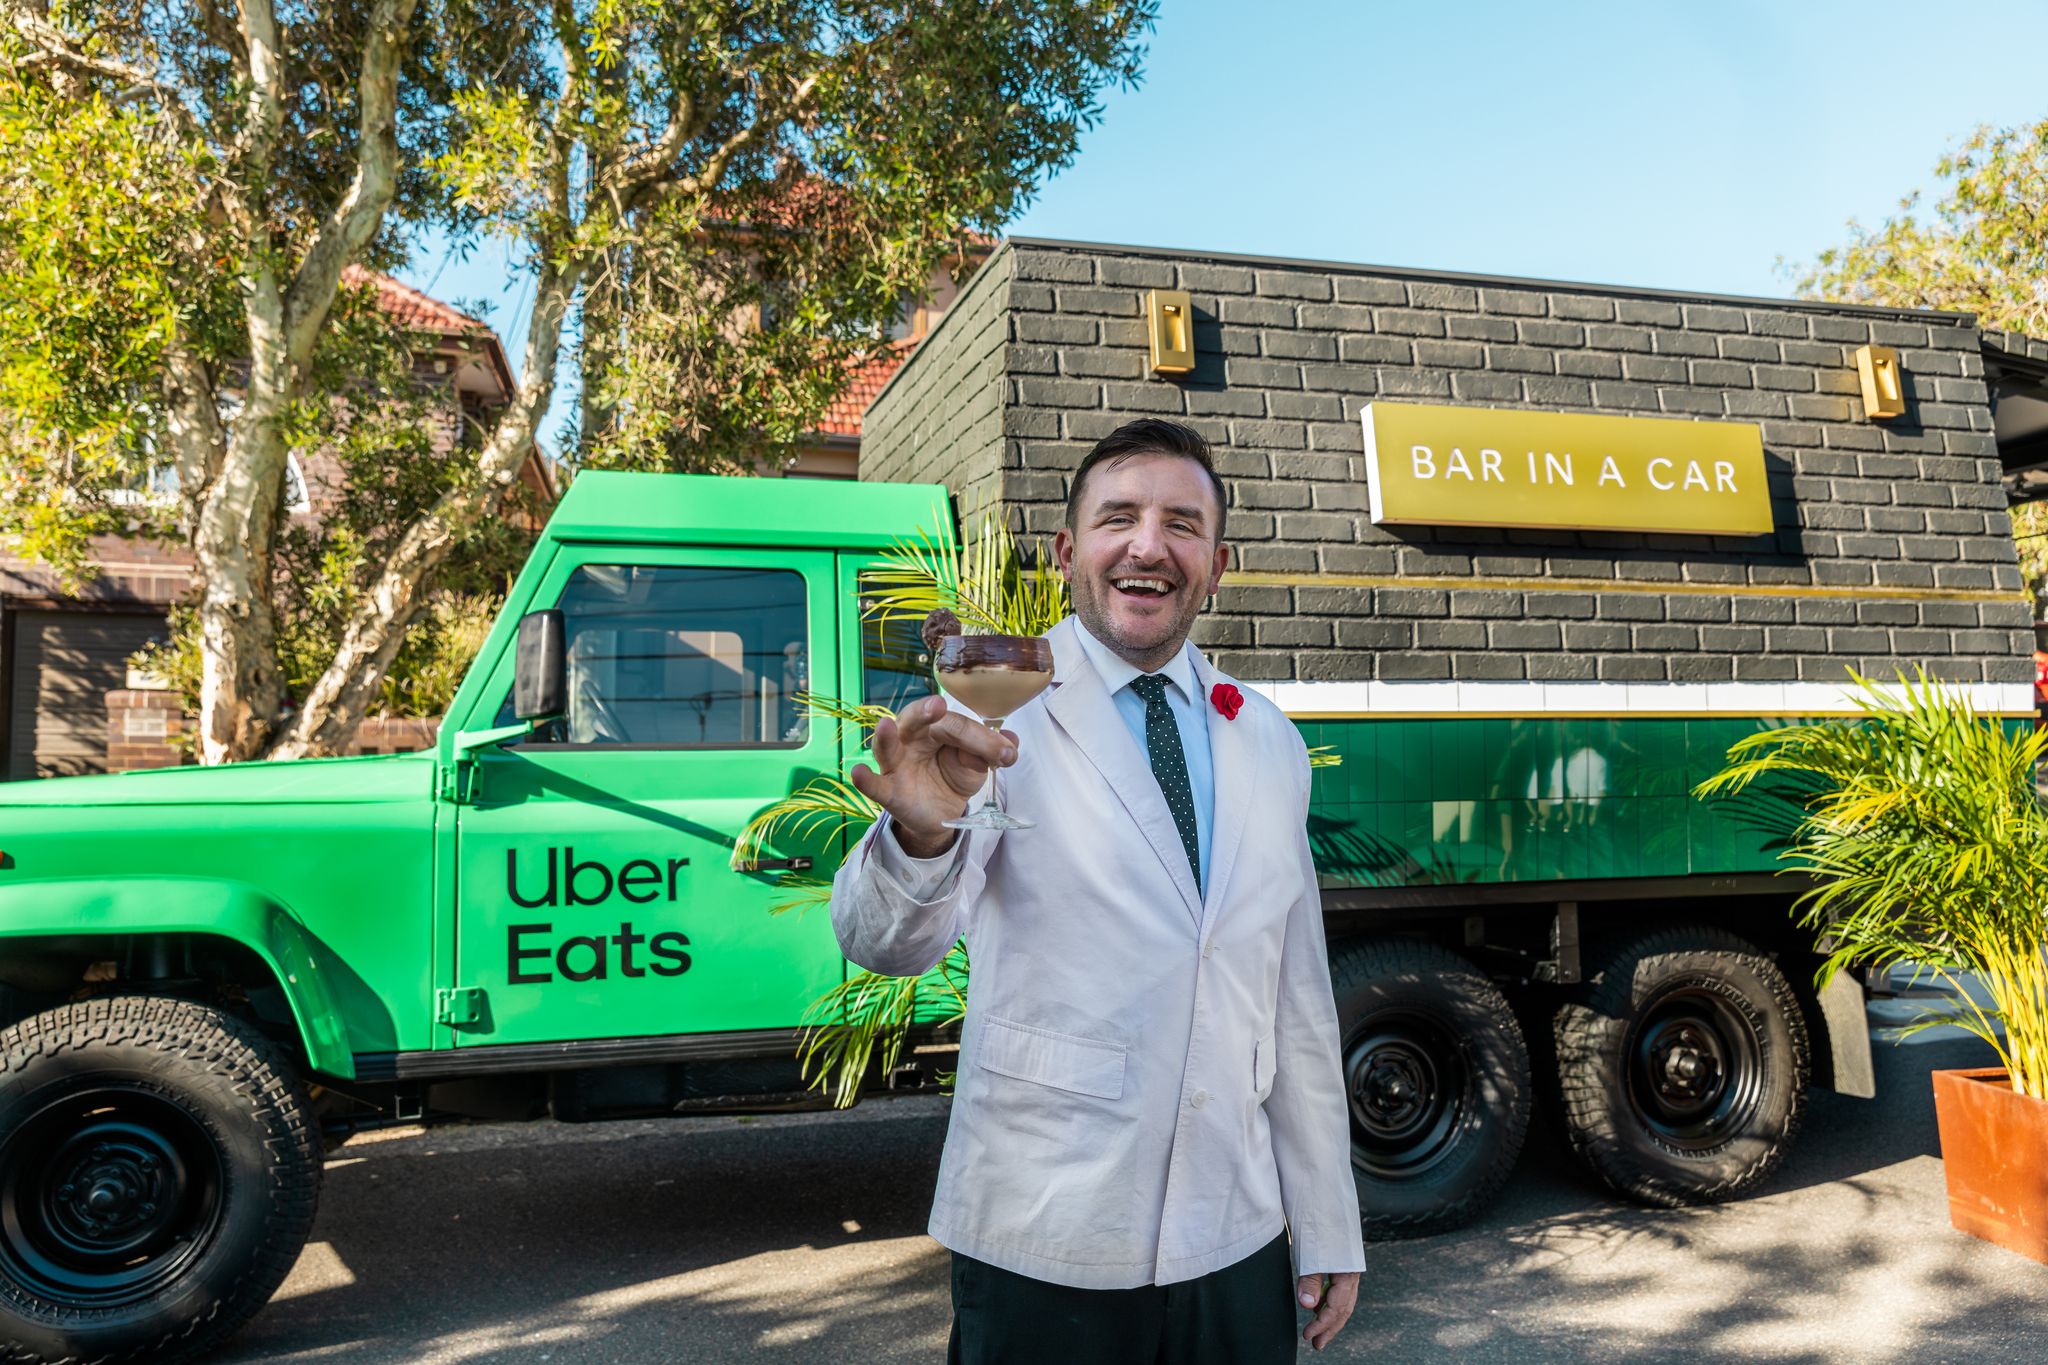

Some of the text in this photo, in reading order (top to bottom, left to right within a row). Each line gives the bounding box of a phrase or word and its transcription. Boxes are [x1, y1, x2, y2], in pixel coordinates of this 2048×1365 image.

[1411, 445, 1738, 493] BAR IN A CAR
[507, 846, 690, 908] Uber
[507, 922, 692, 985] Eats
